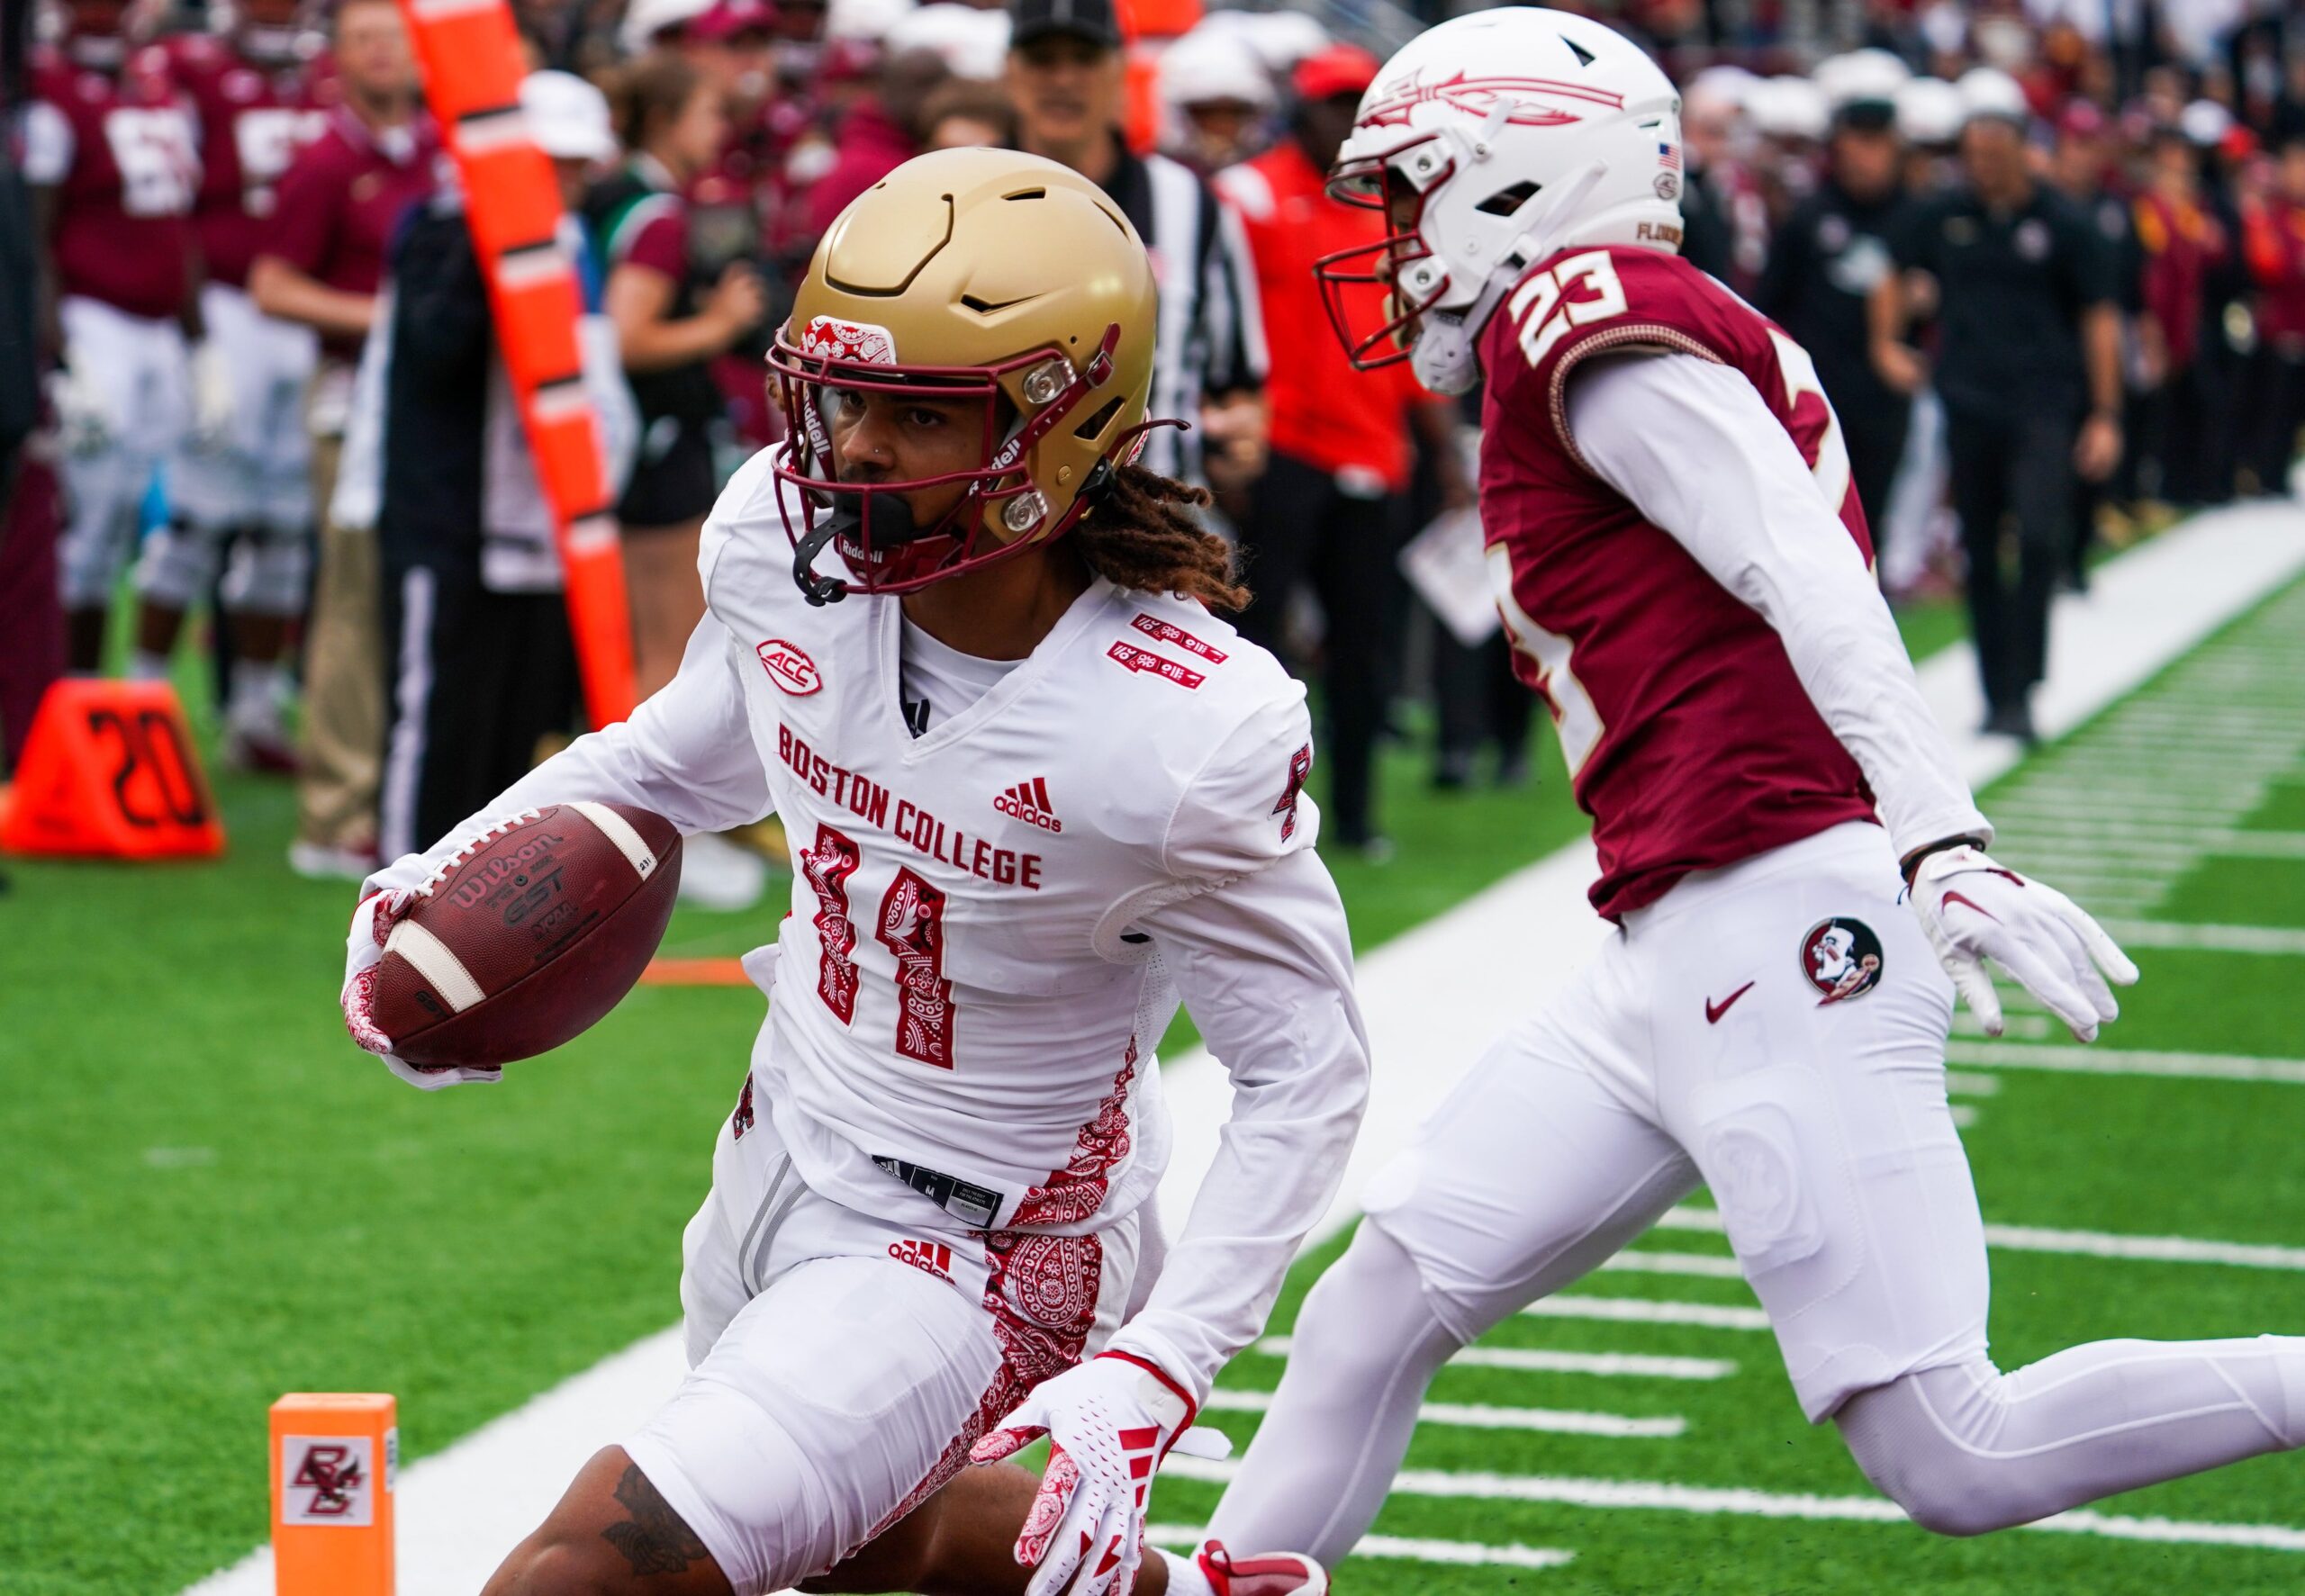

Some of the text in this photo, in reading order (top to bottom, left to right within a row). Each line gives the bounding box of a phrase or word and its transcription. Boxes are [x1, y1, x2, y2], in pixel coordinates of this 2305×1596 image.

[1508, 250, 1628, 369] 23
[803, 388, 831, 455] iddell
[767, 648, 812, 687] ACC
[88, 707, 205, 827] 20
[778, 721, 1042, 891] BOSTON COLLEGE
[993, 794, 1062, 834] adidas
[450, 834, 564, 911] Wilson
[504, 865, 564, 928] GST
[799, 821, 960, 1072] 11
[925, 1185, 936, 1198] M
